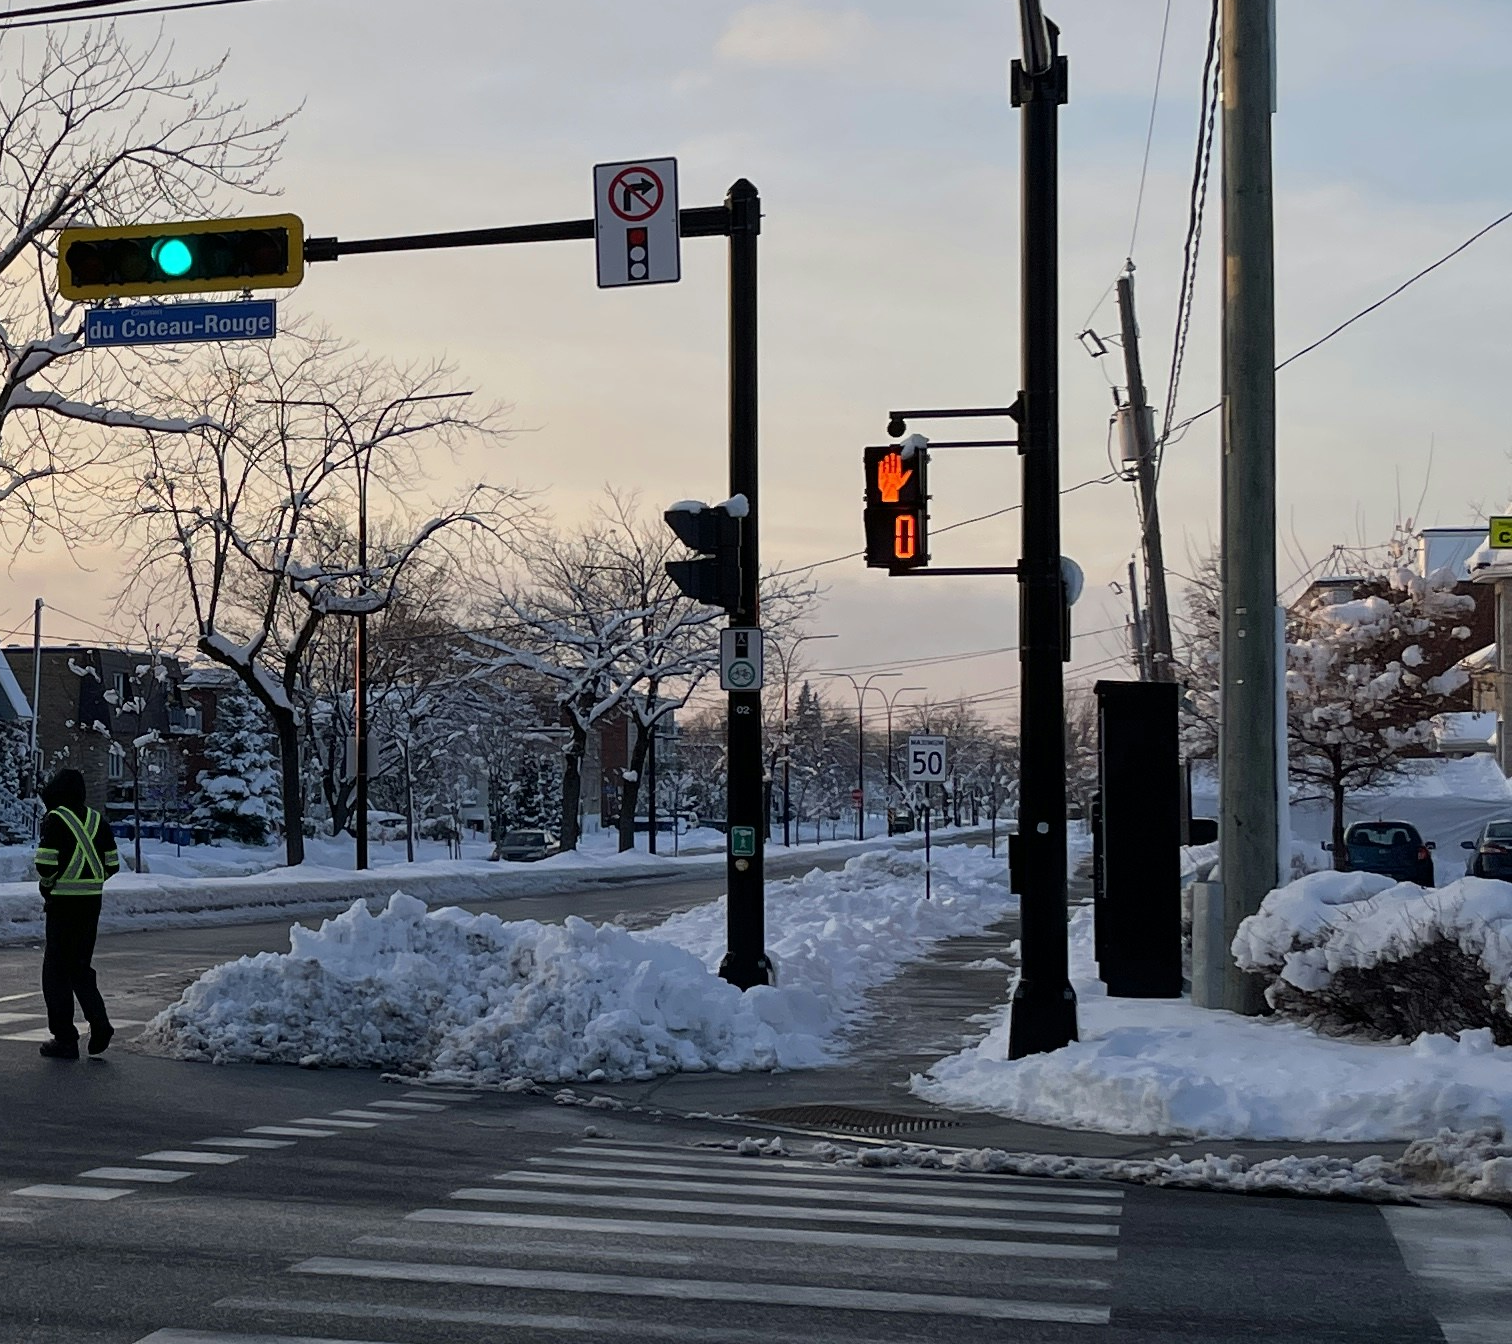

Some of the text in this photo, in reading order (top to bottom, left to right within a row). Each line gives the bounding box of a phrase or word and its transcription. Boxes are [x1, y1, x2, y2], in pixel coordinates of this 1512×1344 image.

[90, 315, 270, 339] du Coteau-Rouge
[895, 515, 915, 558] 0
[913, 751, 942, 775] 50
